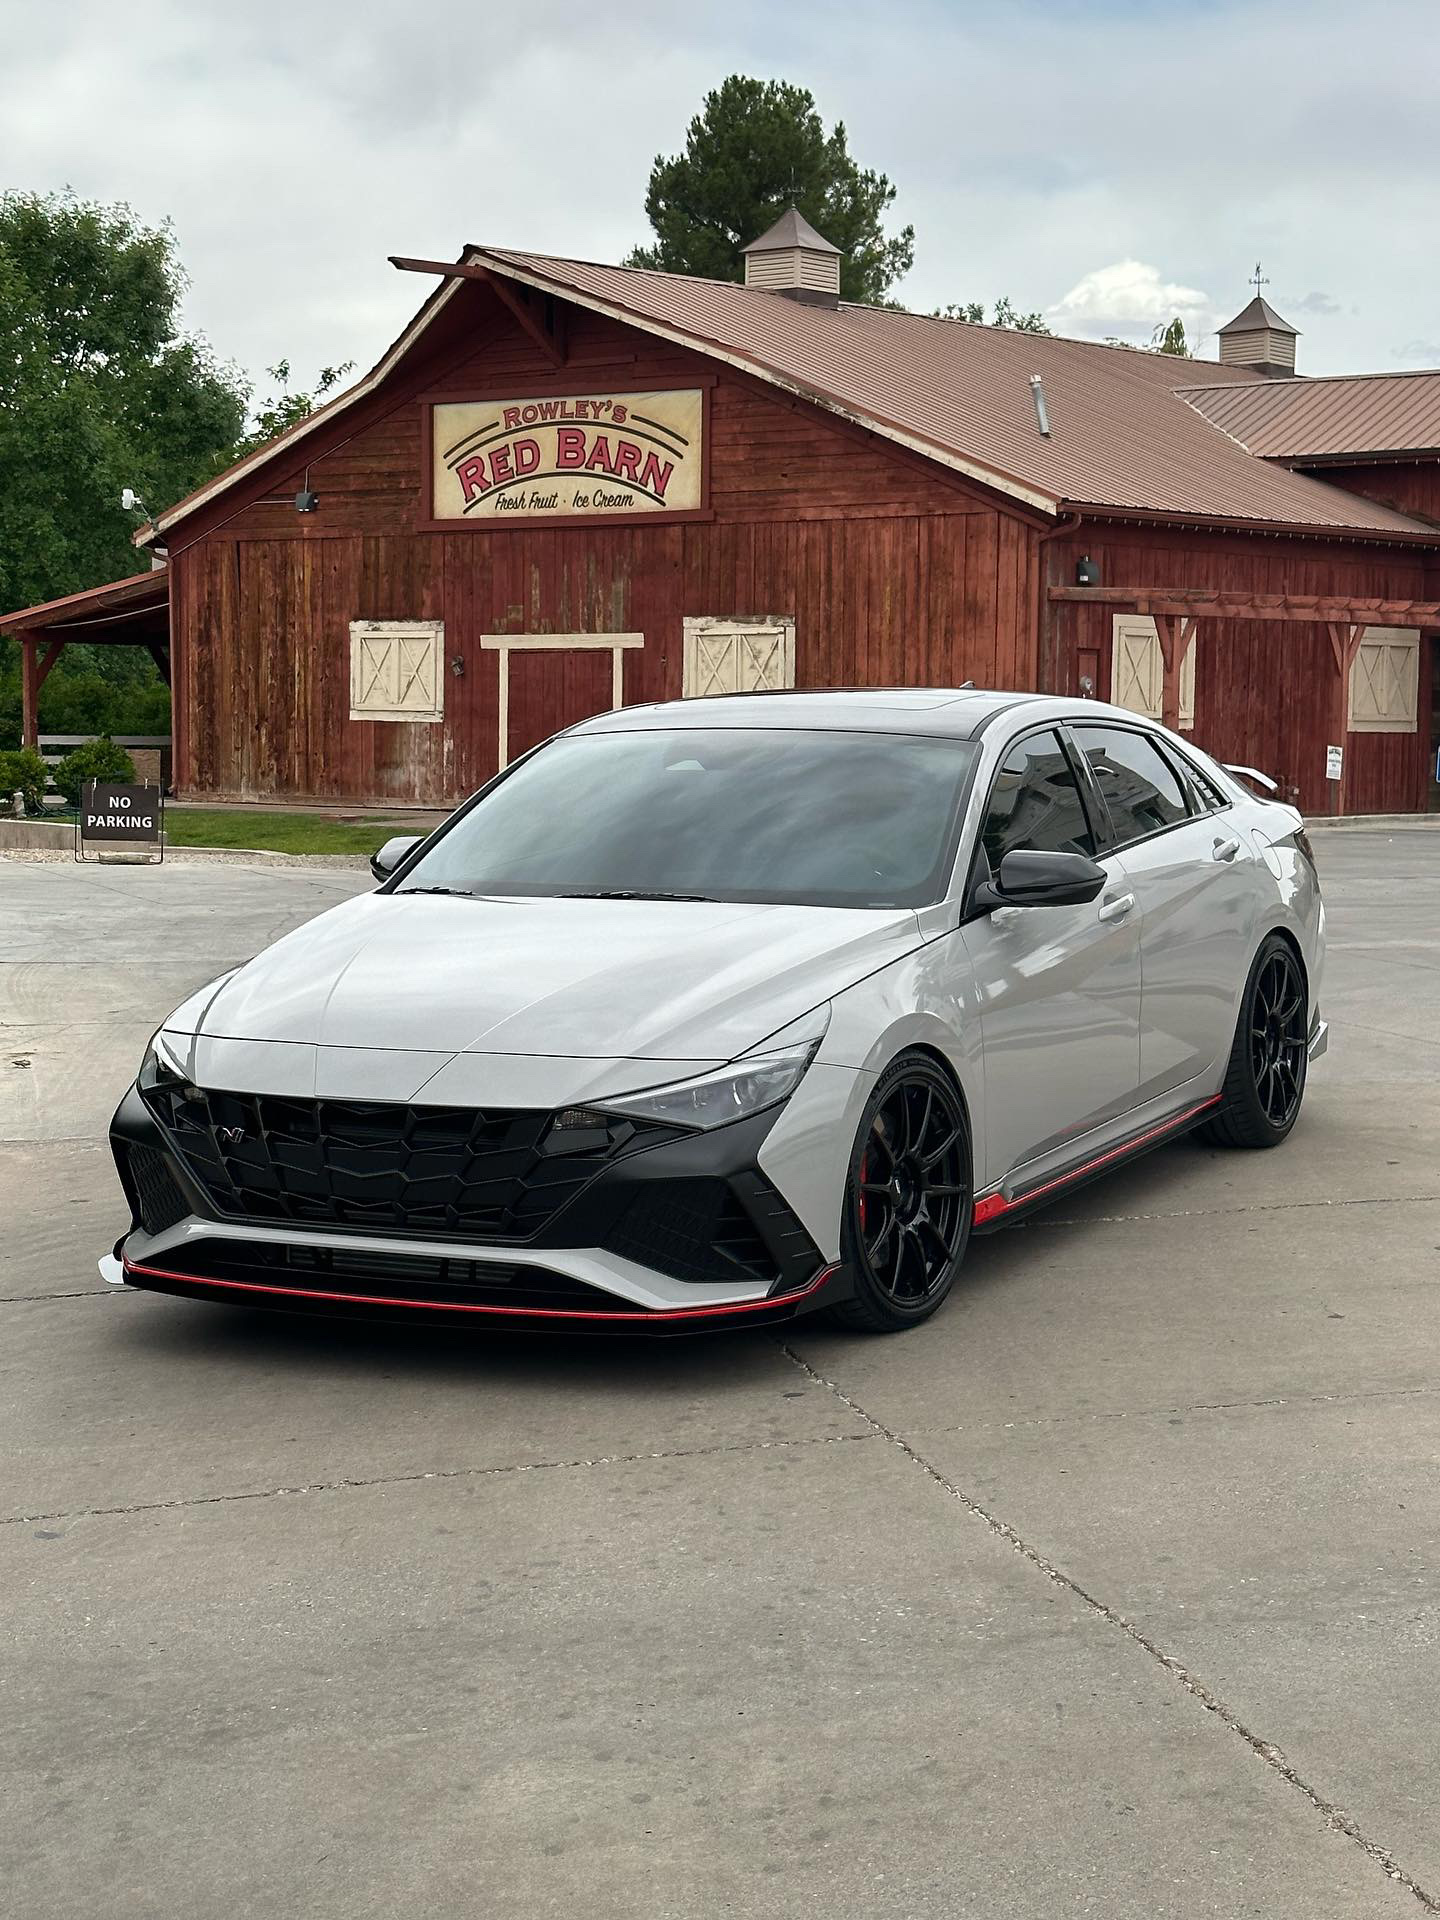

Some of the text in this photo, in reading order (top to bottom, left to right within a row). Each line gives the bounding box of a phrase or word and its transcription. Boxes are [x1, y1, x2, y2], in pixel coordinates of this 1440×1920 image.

[503, 400, 629, 430] ROWLEY'S
[455, 428, 675, 503] RED BARN
[494, 489, 634, 510] Fresh Fruit Ice Cream
[109, 796, 131, 809] NO
[87, 814, 152, 828] PARKING
